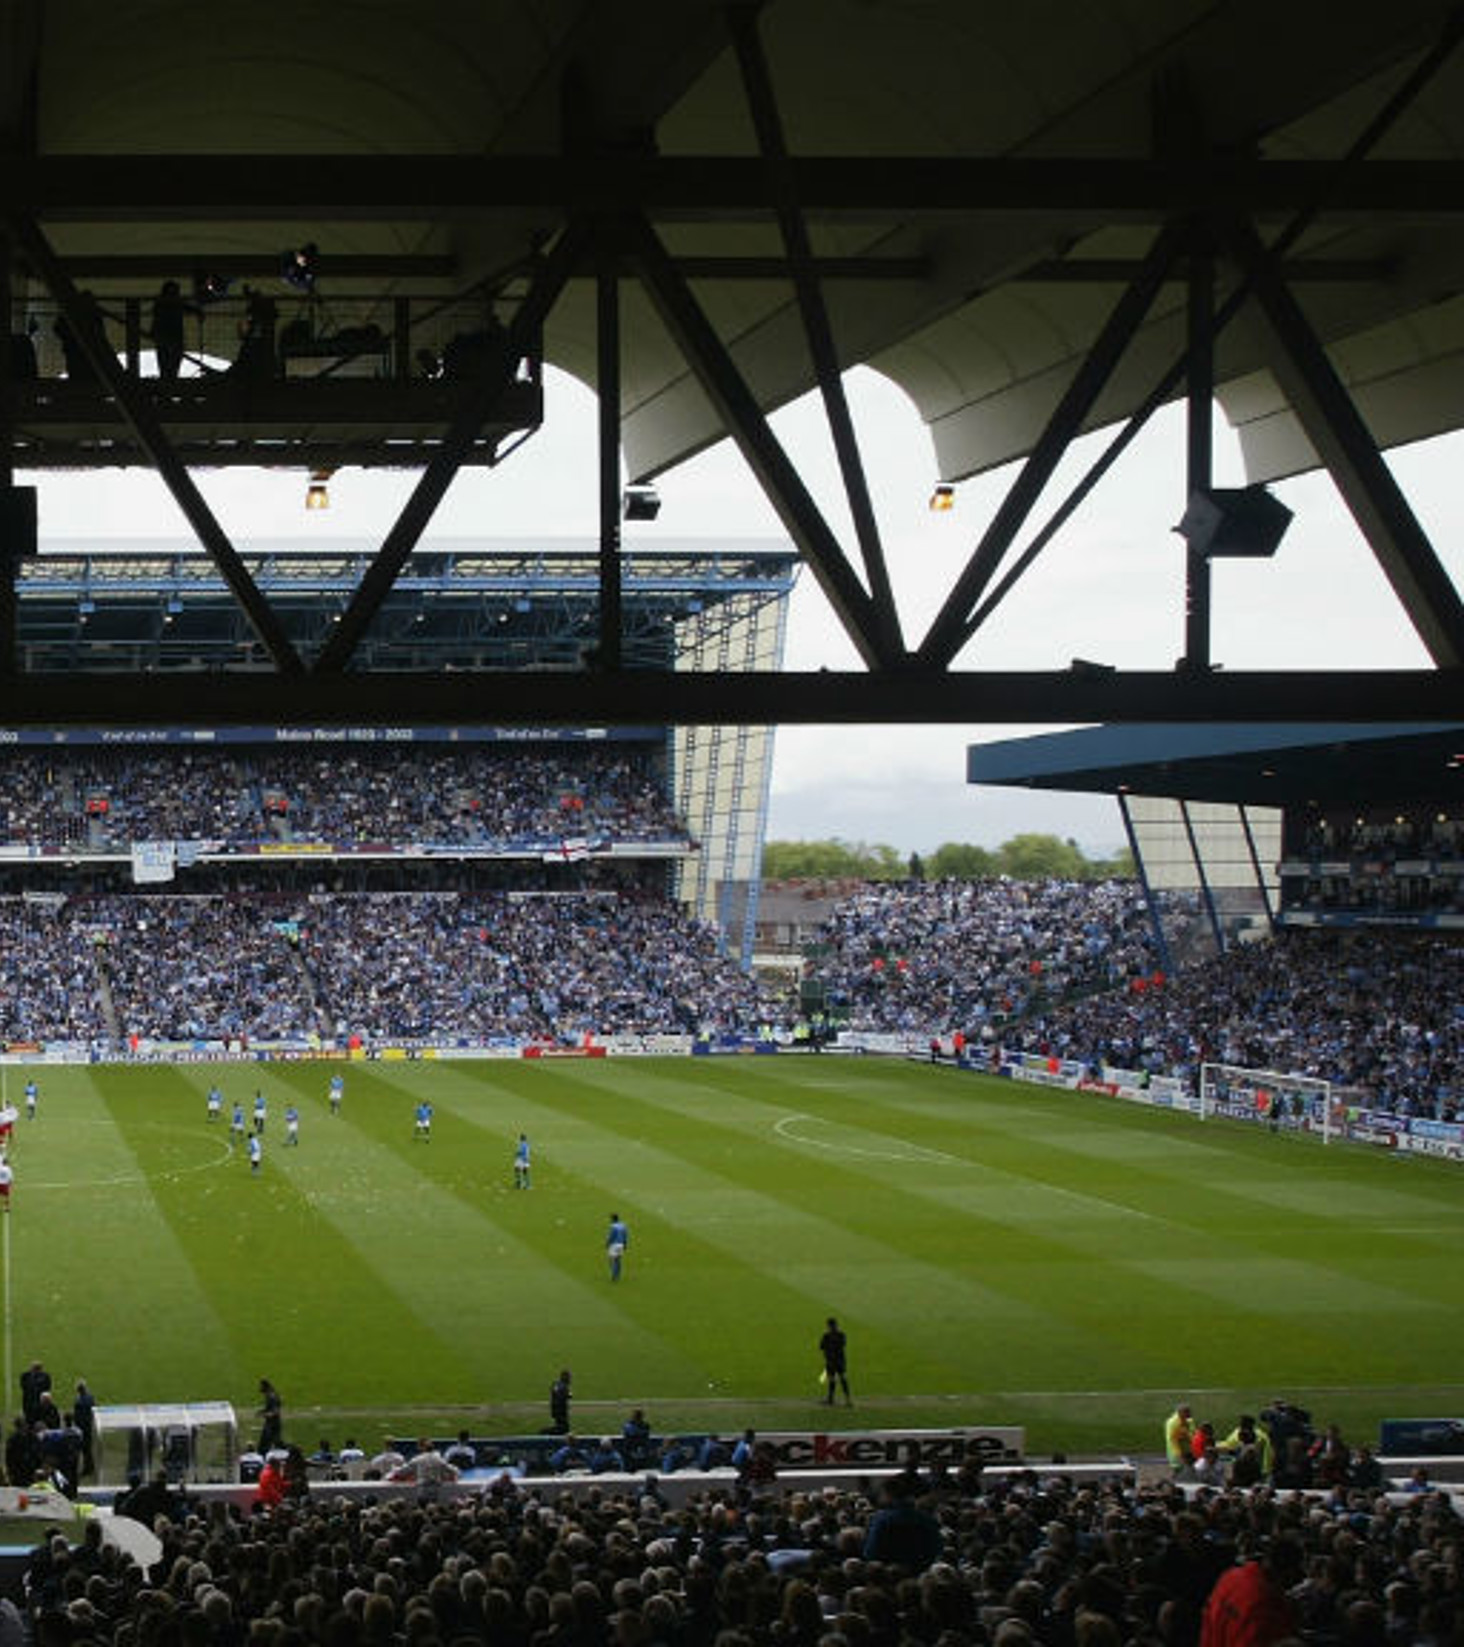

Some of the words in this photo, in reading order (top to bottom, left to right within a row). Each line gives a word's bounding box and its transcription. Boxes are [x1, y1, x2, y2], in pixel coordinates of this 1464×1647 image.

[276, 728, 313, 741] Maine
[314, 728, 347, 741] Road
[385, 728, 413, 741] 2003
